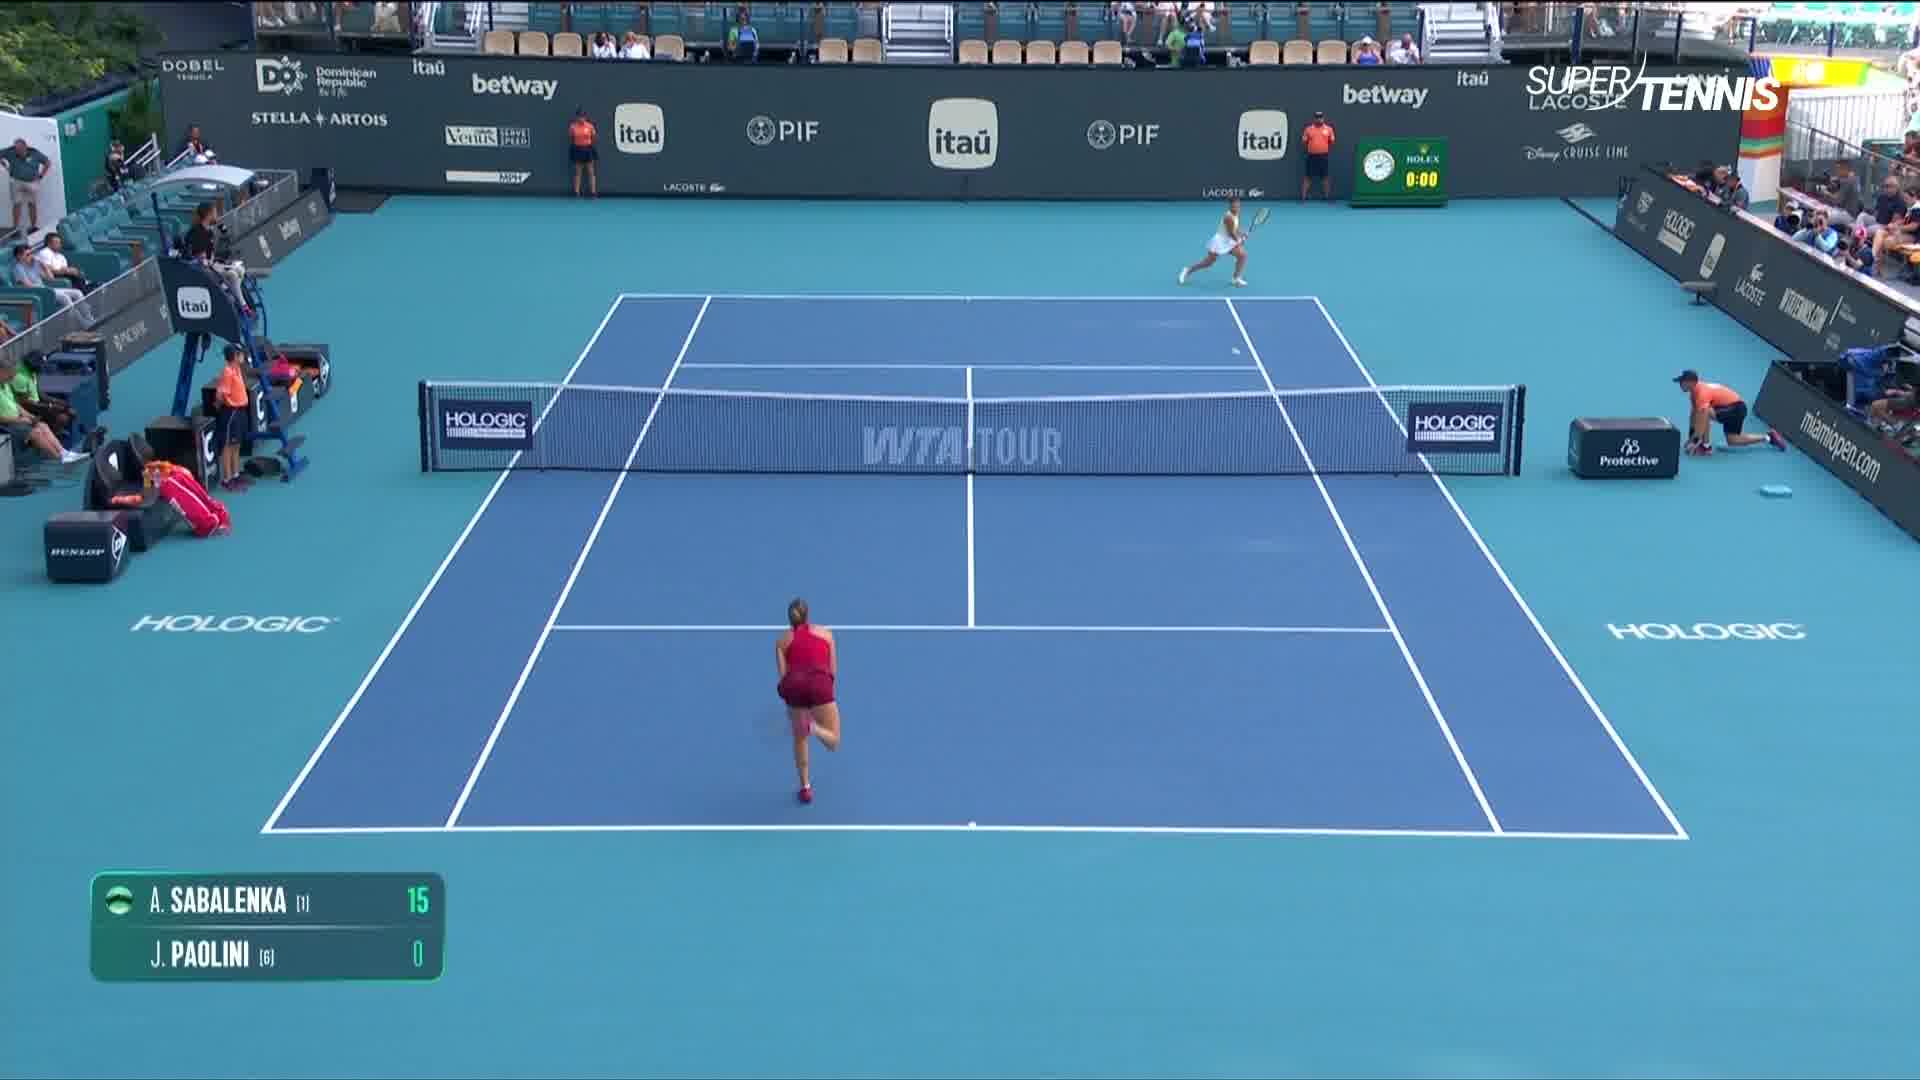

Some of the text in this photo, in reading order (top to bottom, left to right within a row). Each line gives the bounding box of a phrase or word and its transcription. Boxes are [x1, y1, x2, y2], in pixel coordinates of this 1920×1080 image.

[162, 58, 225, 72] DOBEL
[316, 66, 377, 79] Dominican
[317, 77, 368, 89] Republic
[472, 73, 558, 101] betway
[1342, 83, 1429, 109] betway
[251, 111, 389, 127] STELLA ARTOIS
[446, 127, 497, 145] Venus
[619, 123, 660, 144] itaú
[779, 120, 820, 142] PIF
[1119, 124, 1160, 145] PIF
[935, 127, 991, 155] itaú
[1242, 130, 1283, 151] itaú
[663, 183, 706, 192] LACOSTE
[1406, 171, 1438, 188] 0:00
[1201, 188, 1245, 198] LACOSTE
[1735, 278, 1767, 307] LACOSTE
[445, 410, 527, 428] HOLOGIC
[1415, 414, 1496, 431] HOLOGIC
[976, 426, 1062, 465] TOUR
[1800, 409, 1882, 483] miamiopen.com
[1599, 455, 1660, 468] Protective
[51, 547, 105, 557] DUNLOP
[130, 615, 332, 633] HOLOGIC
[1606, 622, 1808, 640] HOLOGIC
